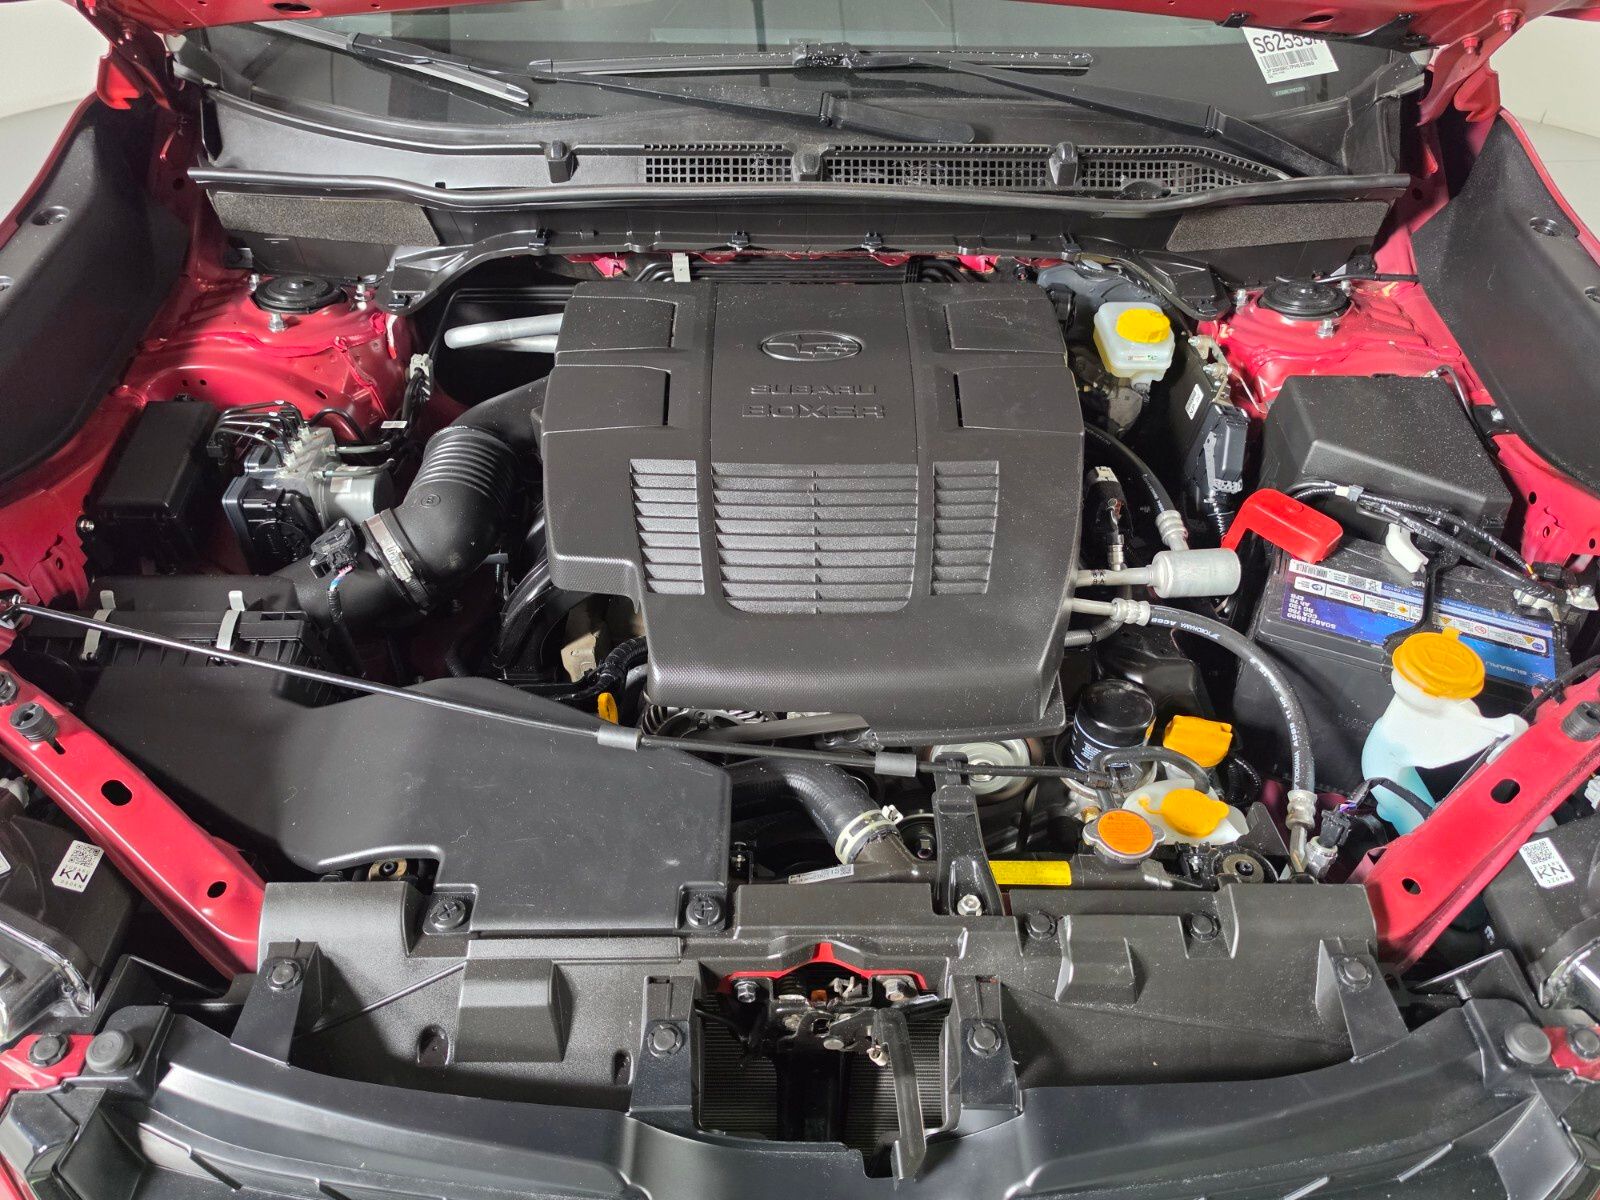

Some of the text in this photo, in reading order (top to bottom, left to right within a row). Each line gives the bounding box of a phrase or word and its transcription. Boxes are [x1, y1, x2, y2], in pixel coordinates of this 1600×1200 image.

[1253, 33, 1324, 54] S62555
[750, 384, 877, 396] SUBARU
[742, 404, 886, 419] BOXER
[1485, 661, 1528, 676] SUBARU
[59, 868, 89, 883] KN
[1536, 864, 1566, 880] KN
